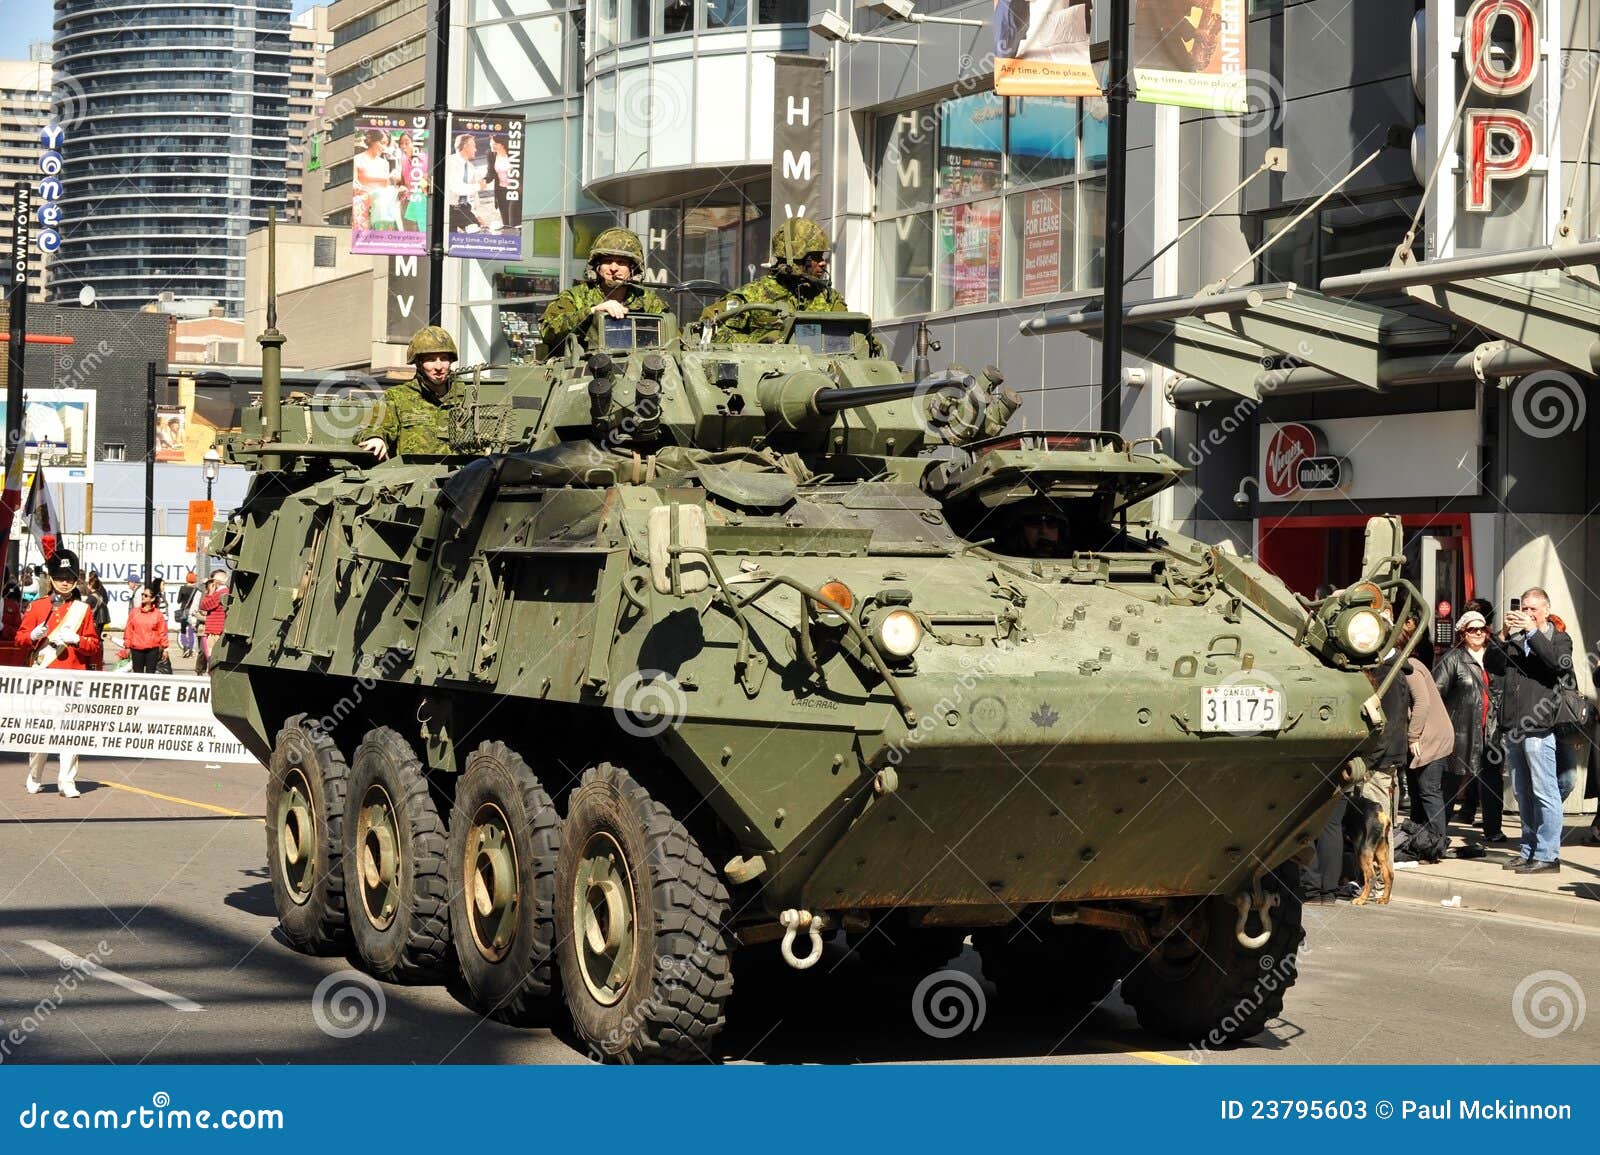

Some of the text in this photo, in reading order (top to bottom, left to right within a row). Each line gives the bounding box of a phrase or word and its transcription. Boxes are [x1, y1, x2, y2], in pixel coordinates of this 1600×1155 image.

[1001, 64, 1015, 74] Any
[1042, 68, 1062, 76] One
[410, 116, 426, 202] SHOPPING
[506, 121, 521, 201] BUSINESS
[39, 124, 65, 253] Yonge
[1031, 198, 1053, 216] RETAIL
[16, 189, 28, 282] DOWNTOWN
[1025, 215, 1059, 237] FOR LEASE
[395, 255, 418, 317] MV
[1269, 430, 1304, 488] Virgin
[1301, 463, 1334, 483] mobile
[111, 539, 126, 552] of
[130, 540, 144, 553] th
[0, 677, 210, 704] HILIPPINE HERITAGE BAN
[1224, 689, 1256, 697] CANADA
[64, 703, 139, 717] SPONSORED BY
[1207, 698, 1274, 722] 31175
[1, 717, 21, 729] ZEN
[60, 720, 115, 733] MURPHY'S
[118, 722, 143, 736] LAW,
[147, 724, 217, 739] WATERMARK,
[9, 733, 45, 745] POGUE
[49, 735, 98, 749] MAHONE,
[102, 736, 122, 748] THE
[125, 738, 154, 750] POUR
[158, 740, 194, 752] HOUSE
[196, 742, 204, 752] &
